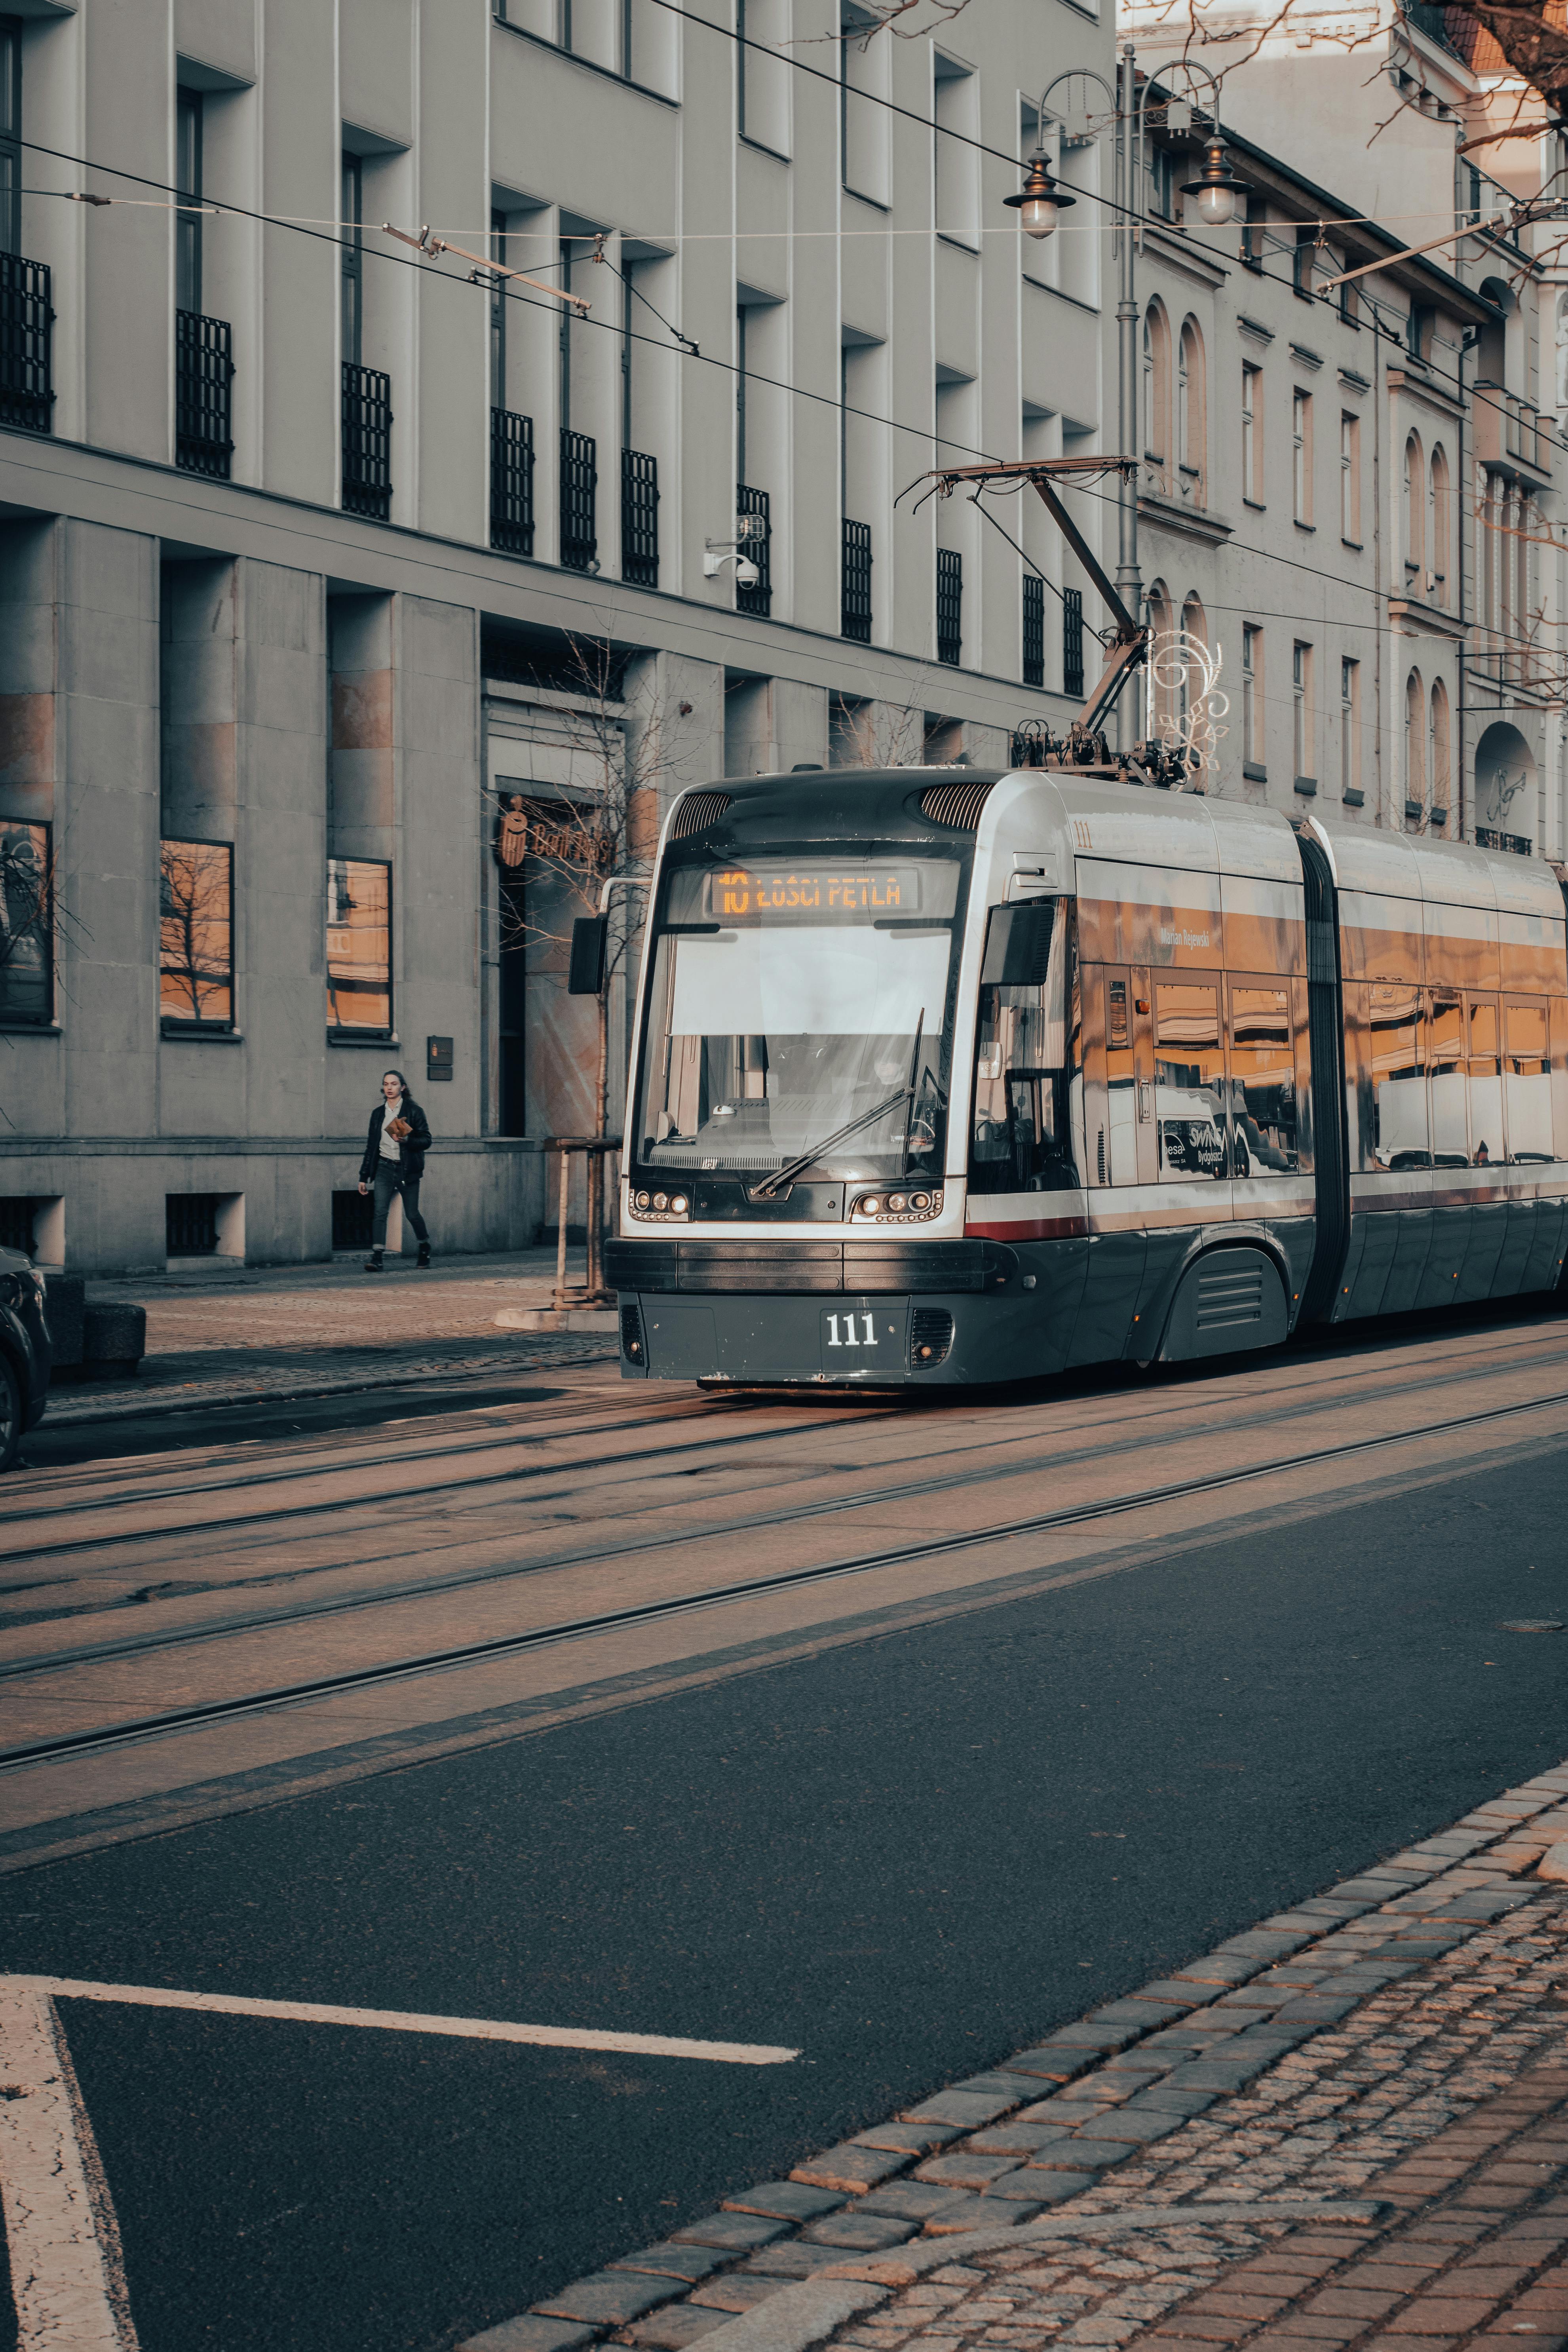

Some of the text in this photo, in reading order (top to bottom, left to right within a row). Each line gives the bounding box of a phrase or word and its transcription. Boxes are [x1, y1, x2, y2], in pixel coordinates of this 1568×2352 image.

[1074, 819, 1093, 848] 111
[718, 873, 749, 913] 10
[1161, 928, 1209, 951] Marian Rejewski
[1198, 1150, 1223, 1165] Bydgoszcz
[827, 1313, 878, 1346] 111
